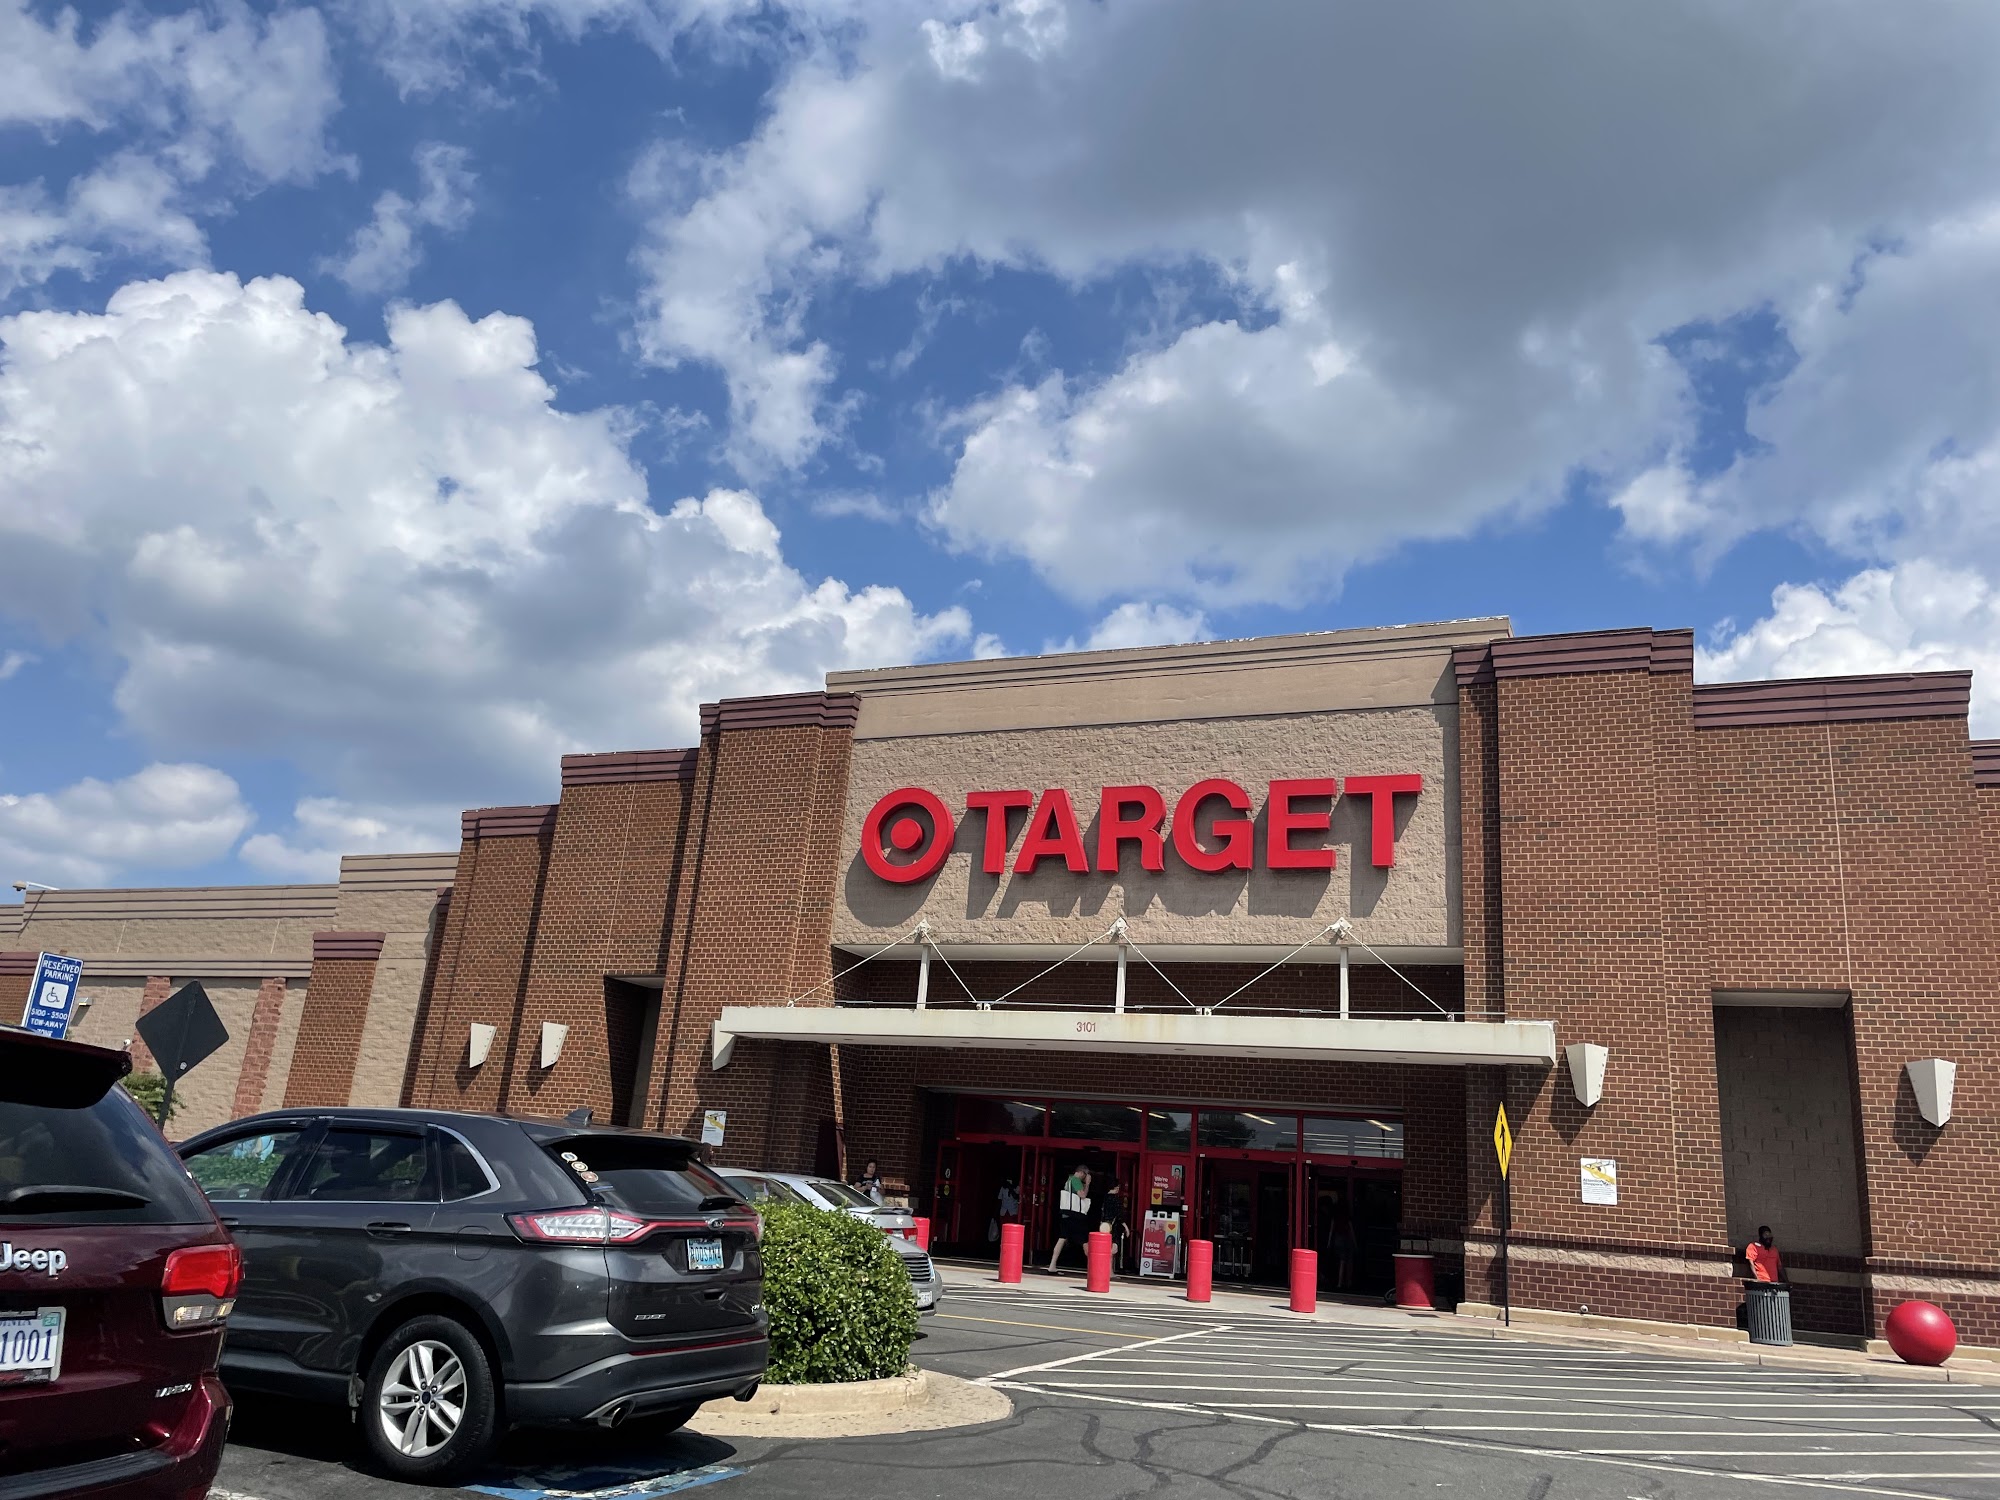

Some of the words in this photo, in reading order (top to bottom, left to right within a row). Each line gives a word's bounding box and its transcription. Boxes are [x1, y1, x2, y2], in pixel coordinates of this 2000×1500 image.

[966, 773, 1422, 875] TARGET
[42, 959, 80, 974] RESERVED
[43, 970, 74, 982] PARKING
[31, 1008, 47, 1016] $100
[51, 1011, 68, 1020] $500
[30, 1018, 64, 1029] TOW-AWAY
[1076, 1021, 1096, 1033] 3101
[0, 1242, 67, 1277] Jeep
[44, 1316, 58, 1325] 24
